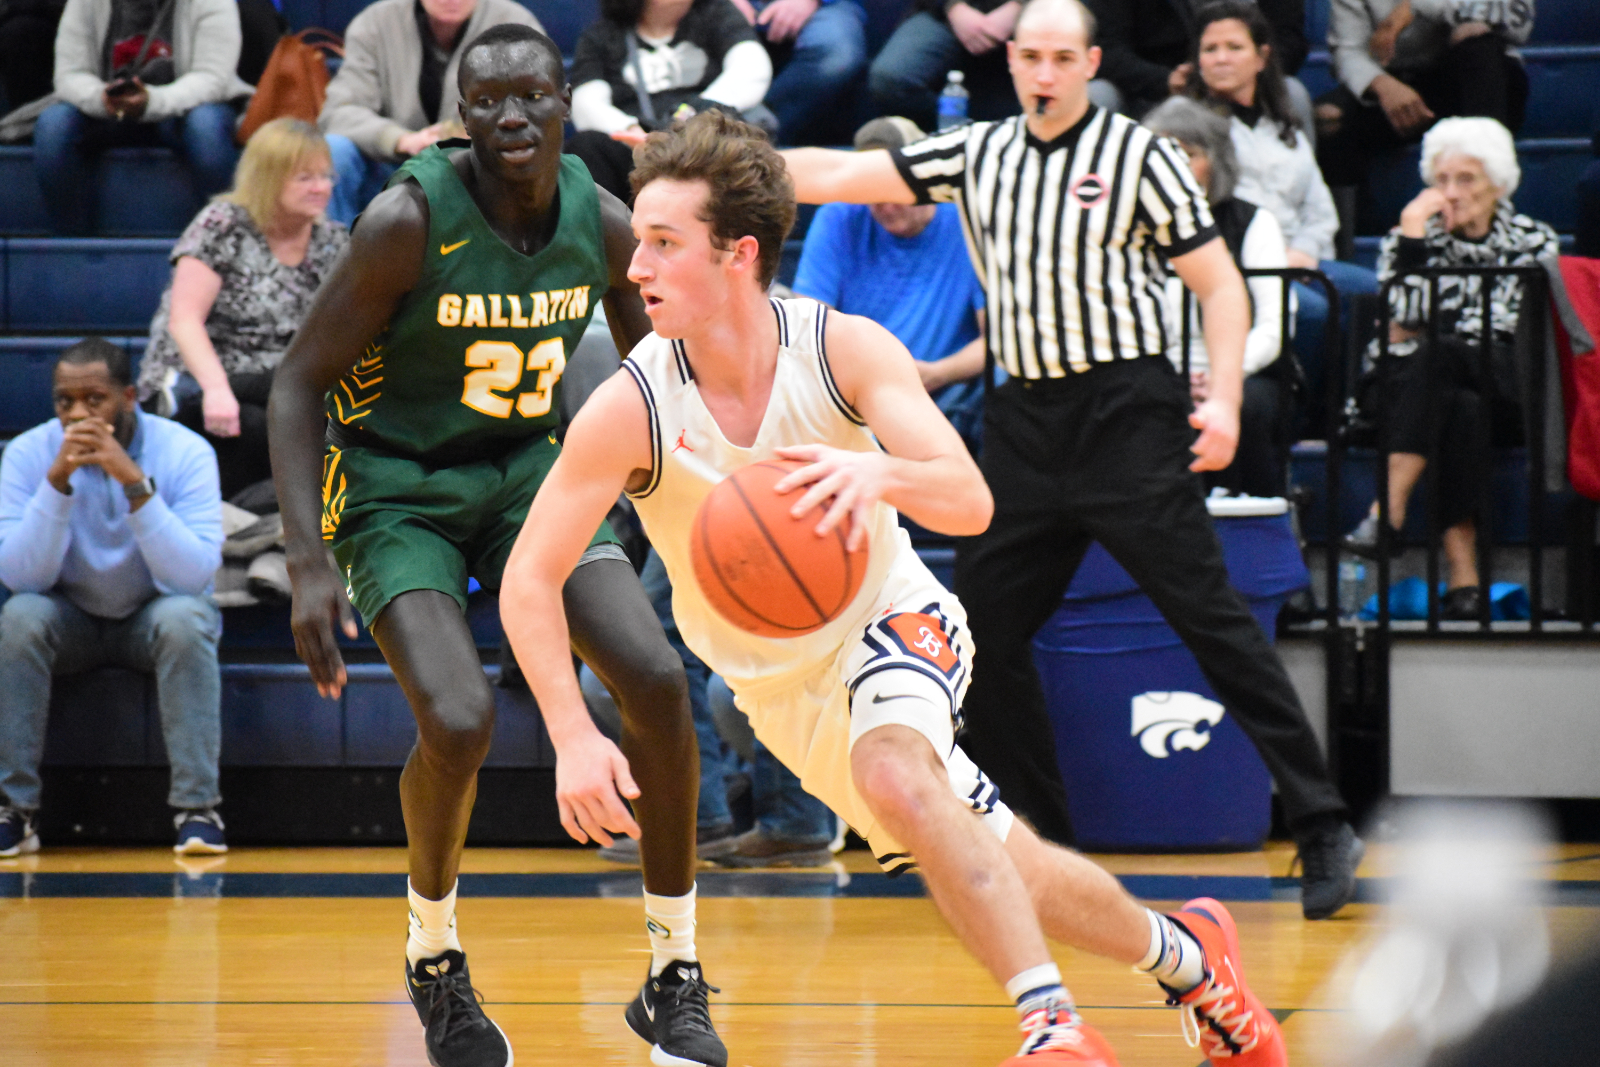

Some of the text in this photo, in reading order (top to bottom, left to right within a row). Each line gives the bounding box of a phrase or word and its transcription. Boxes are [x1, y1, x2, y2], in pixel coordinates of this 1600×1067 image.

[437, 285, 591, 328] GALLATIN
[460, 336, 566, 419] 23
[913, 626, 943, 658] B
